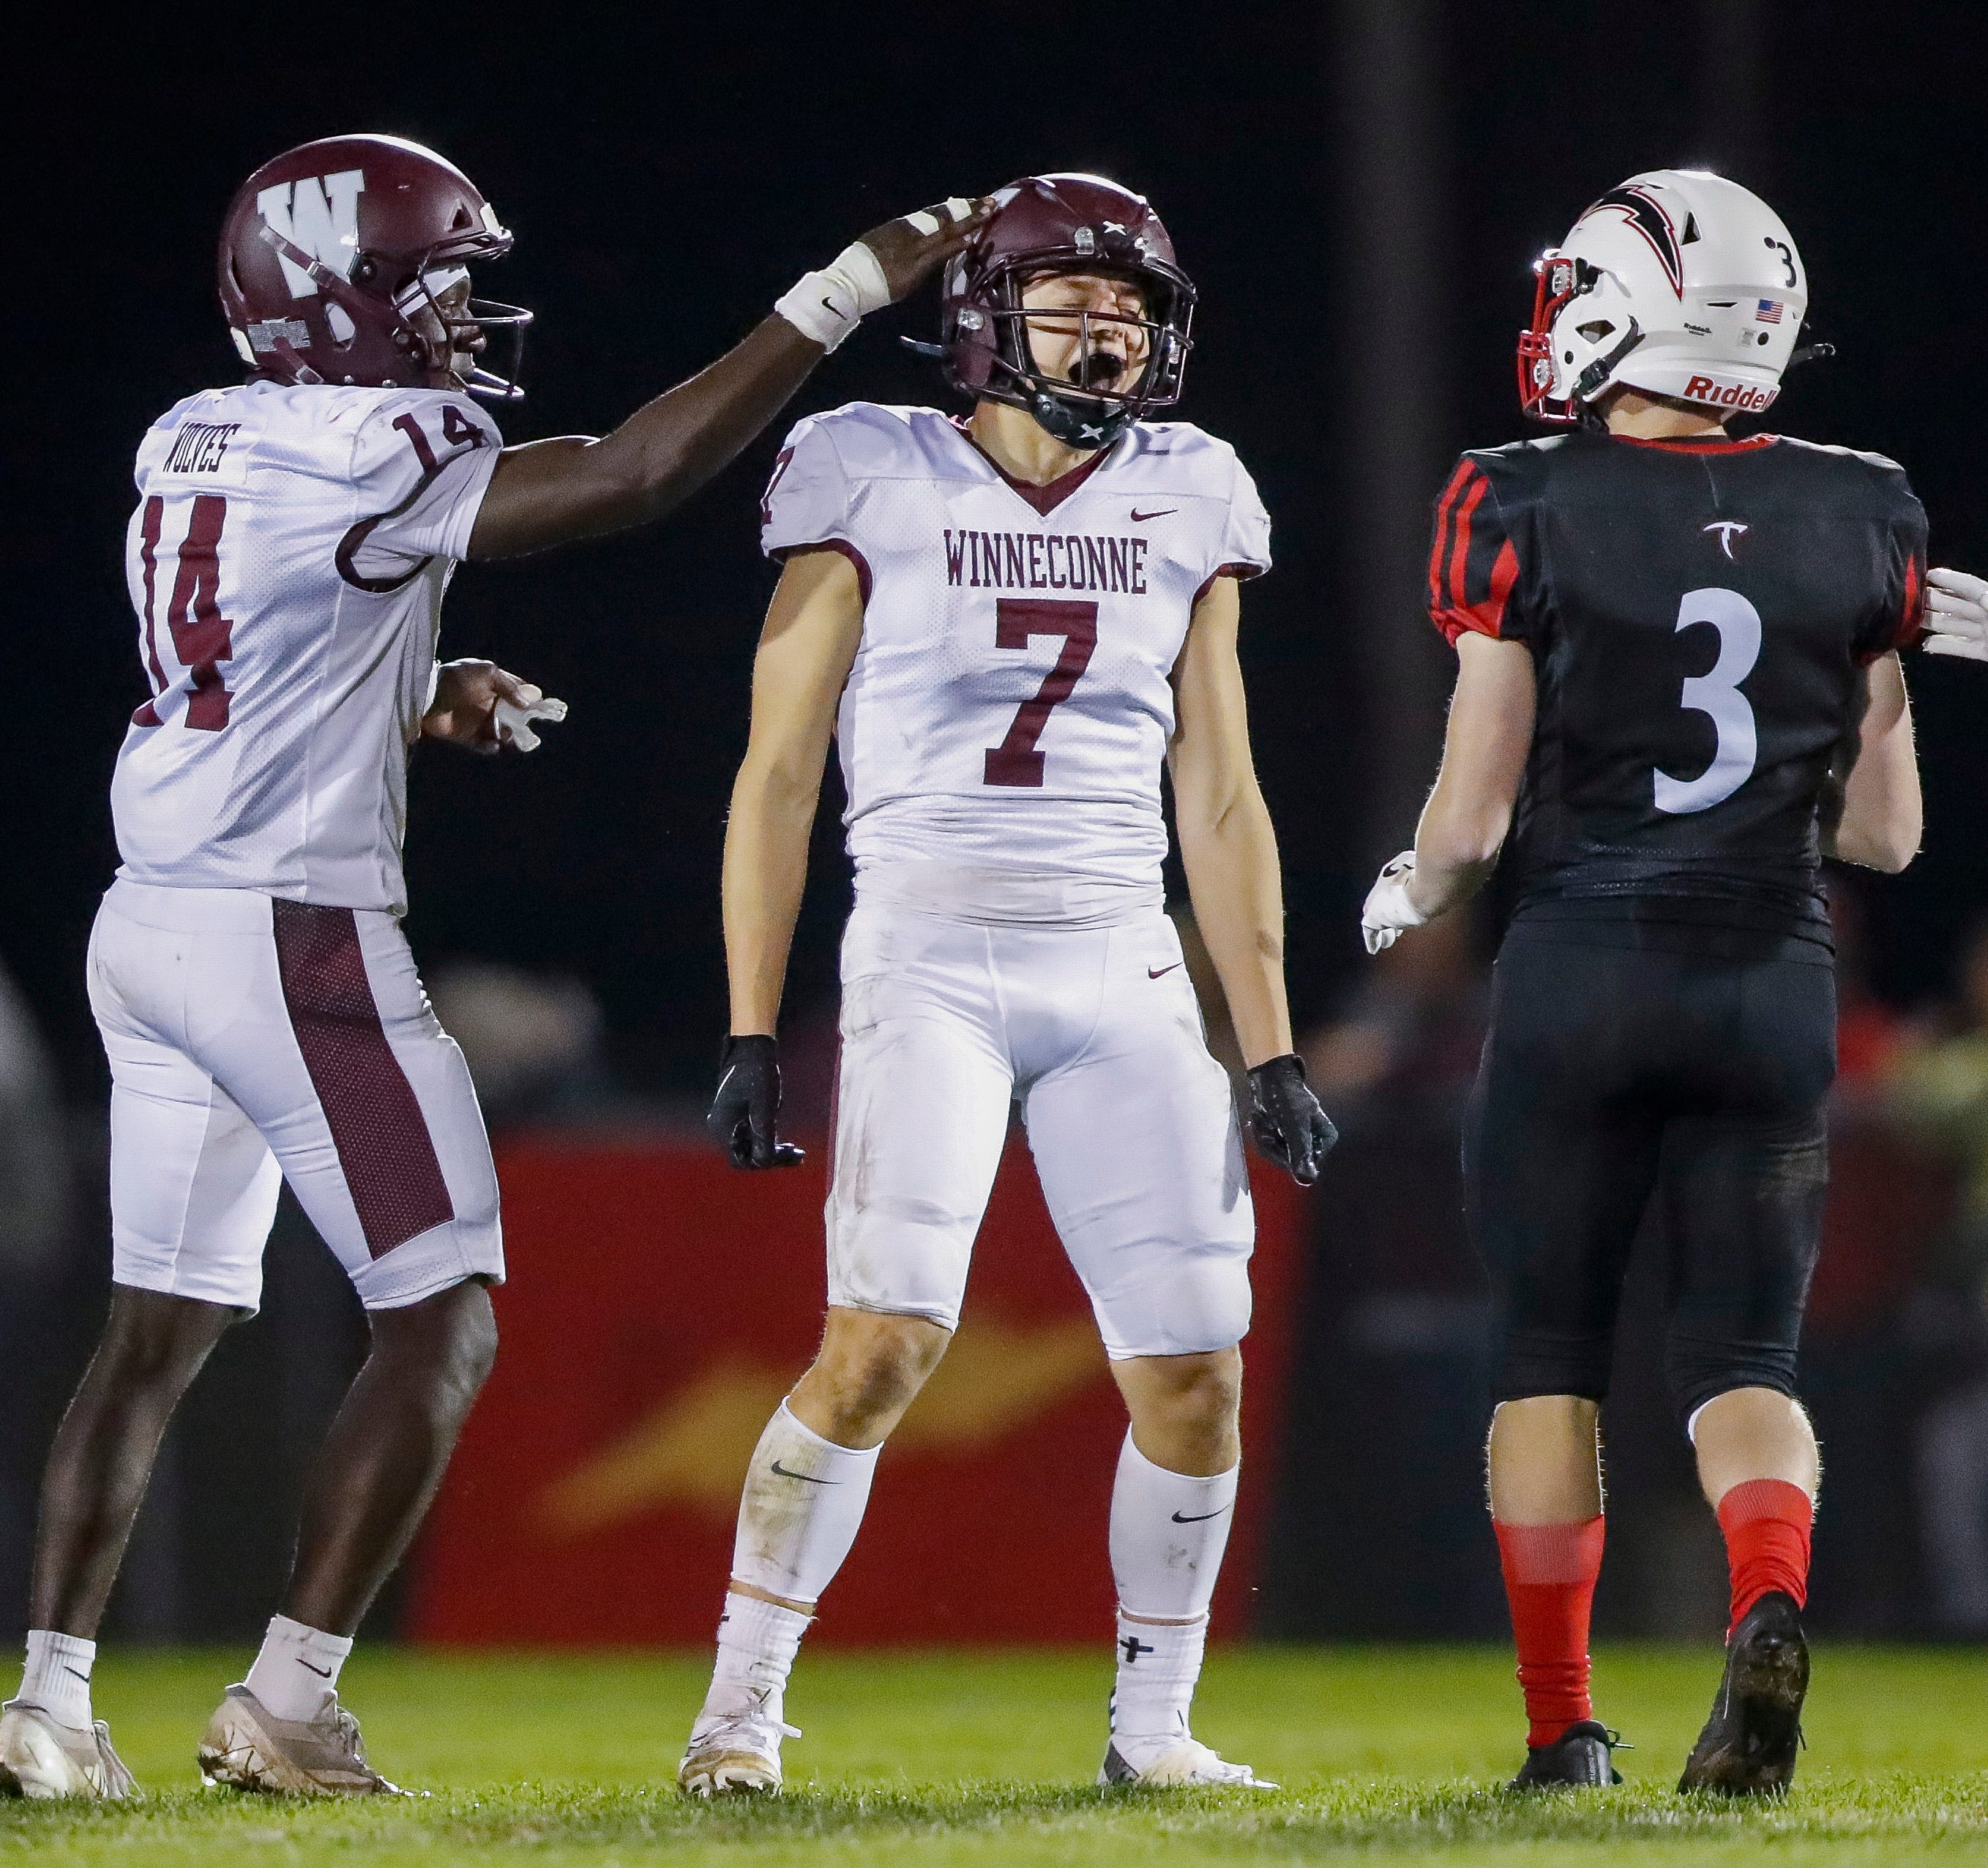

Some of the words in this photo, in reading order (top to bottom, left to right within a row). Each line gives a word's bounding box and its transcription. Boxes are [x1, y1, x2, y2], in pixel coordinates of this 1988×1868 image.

[257, 168, 365, 299] W
[1770, 241, 1797, 288] 3
[1683, 375, 1778, 410] Riddell
[162, 421, 242, 473] WOLVES
[392, 404, 485, 474] 14
[943, 529, 1148, 594] WINNECONNE
[132, 496, 236, 732] 14
[982, 597, 1099, 788] 7
[1653, 587, 1763, 814] 3
